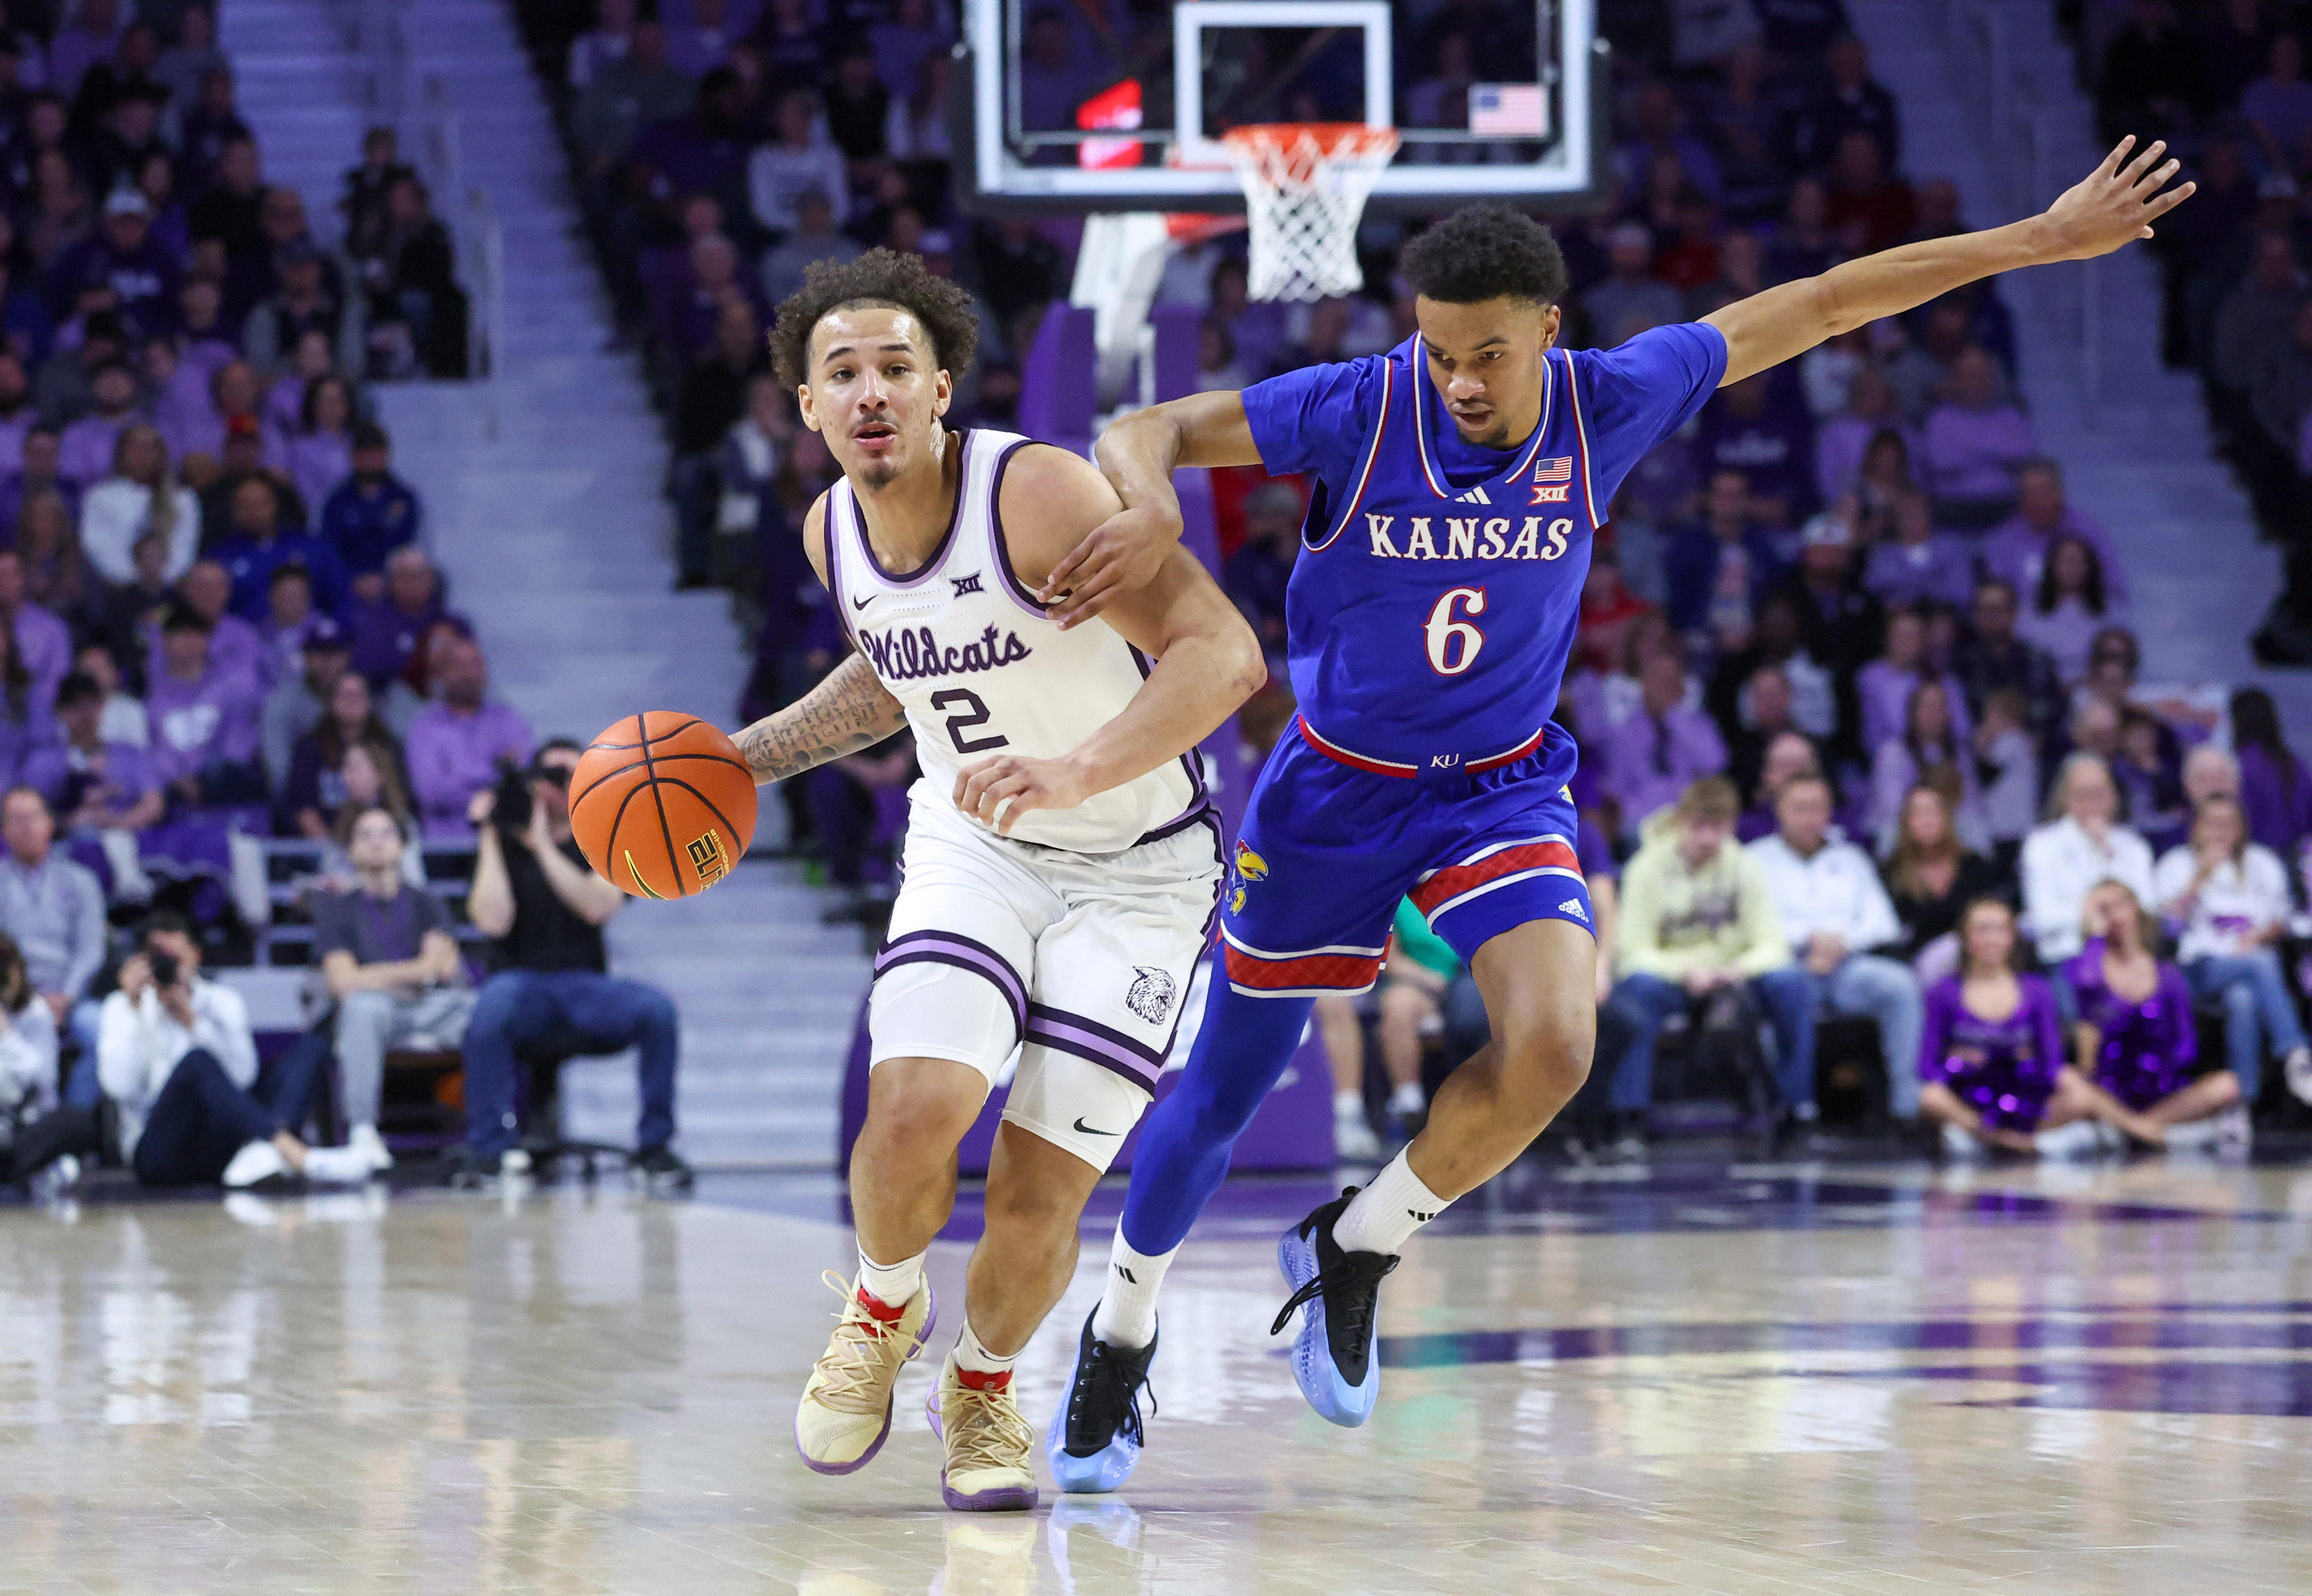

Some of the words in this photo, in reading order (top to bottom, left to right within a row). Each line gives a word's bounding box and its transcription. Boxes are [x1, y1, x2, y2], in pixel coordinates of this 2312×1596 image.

[1530, 483, 1570, 504] XII
[1365, 512, 1573, 560] KANSAS
[950, 572, 984, 598] XII
[1422, 585, 1488, 677] 6
[859, 621, 1032, 679] Wildcats
[930, 688, 1010, 754] 2
[1429, 753, 1459, 768] KU
[1558, 904, 1589, 923] adidas
